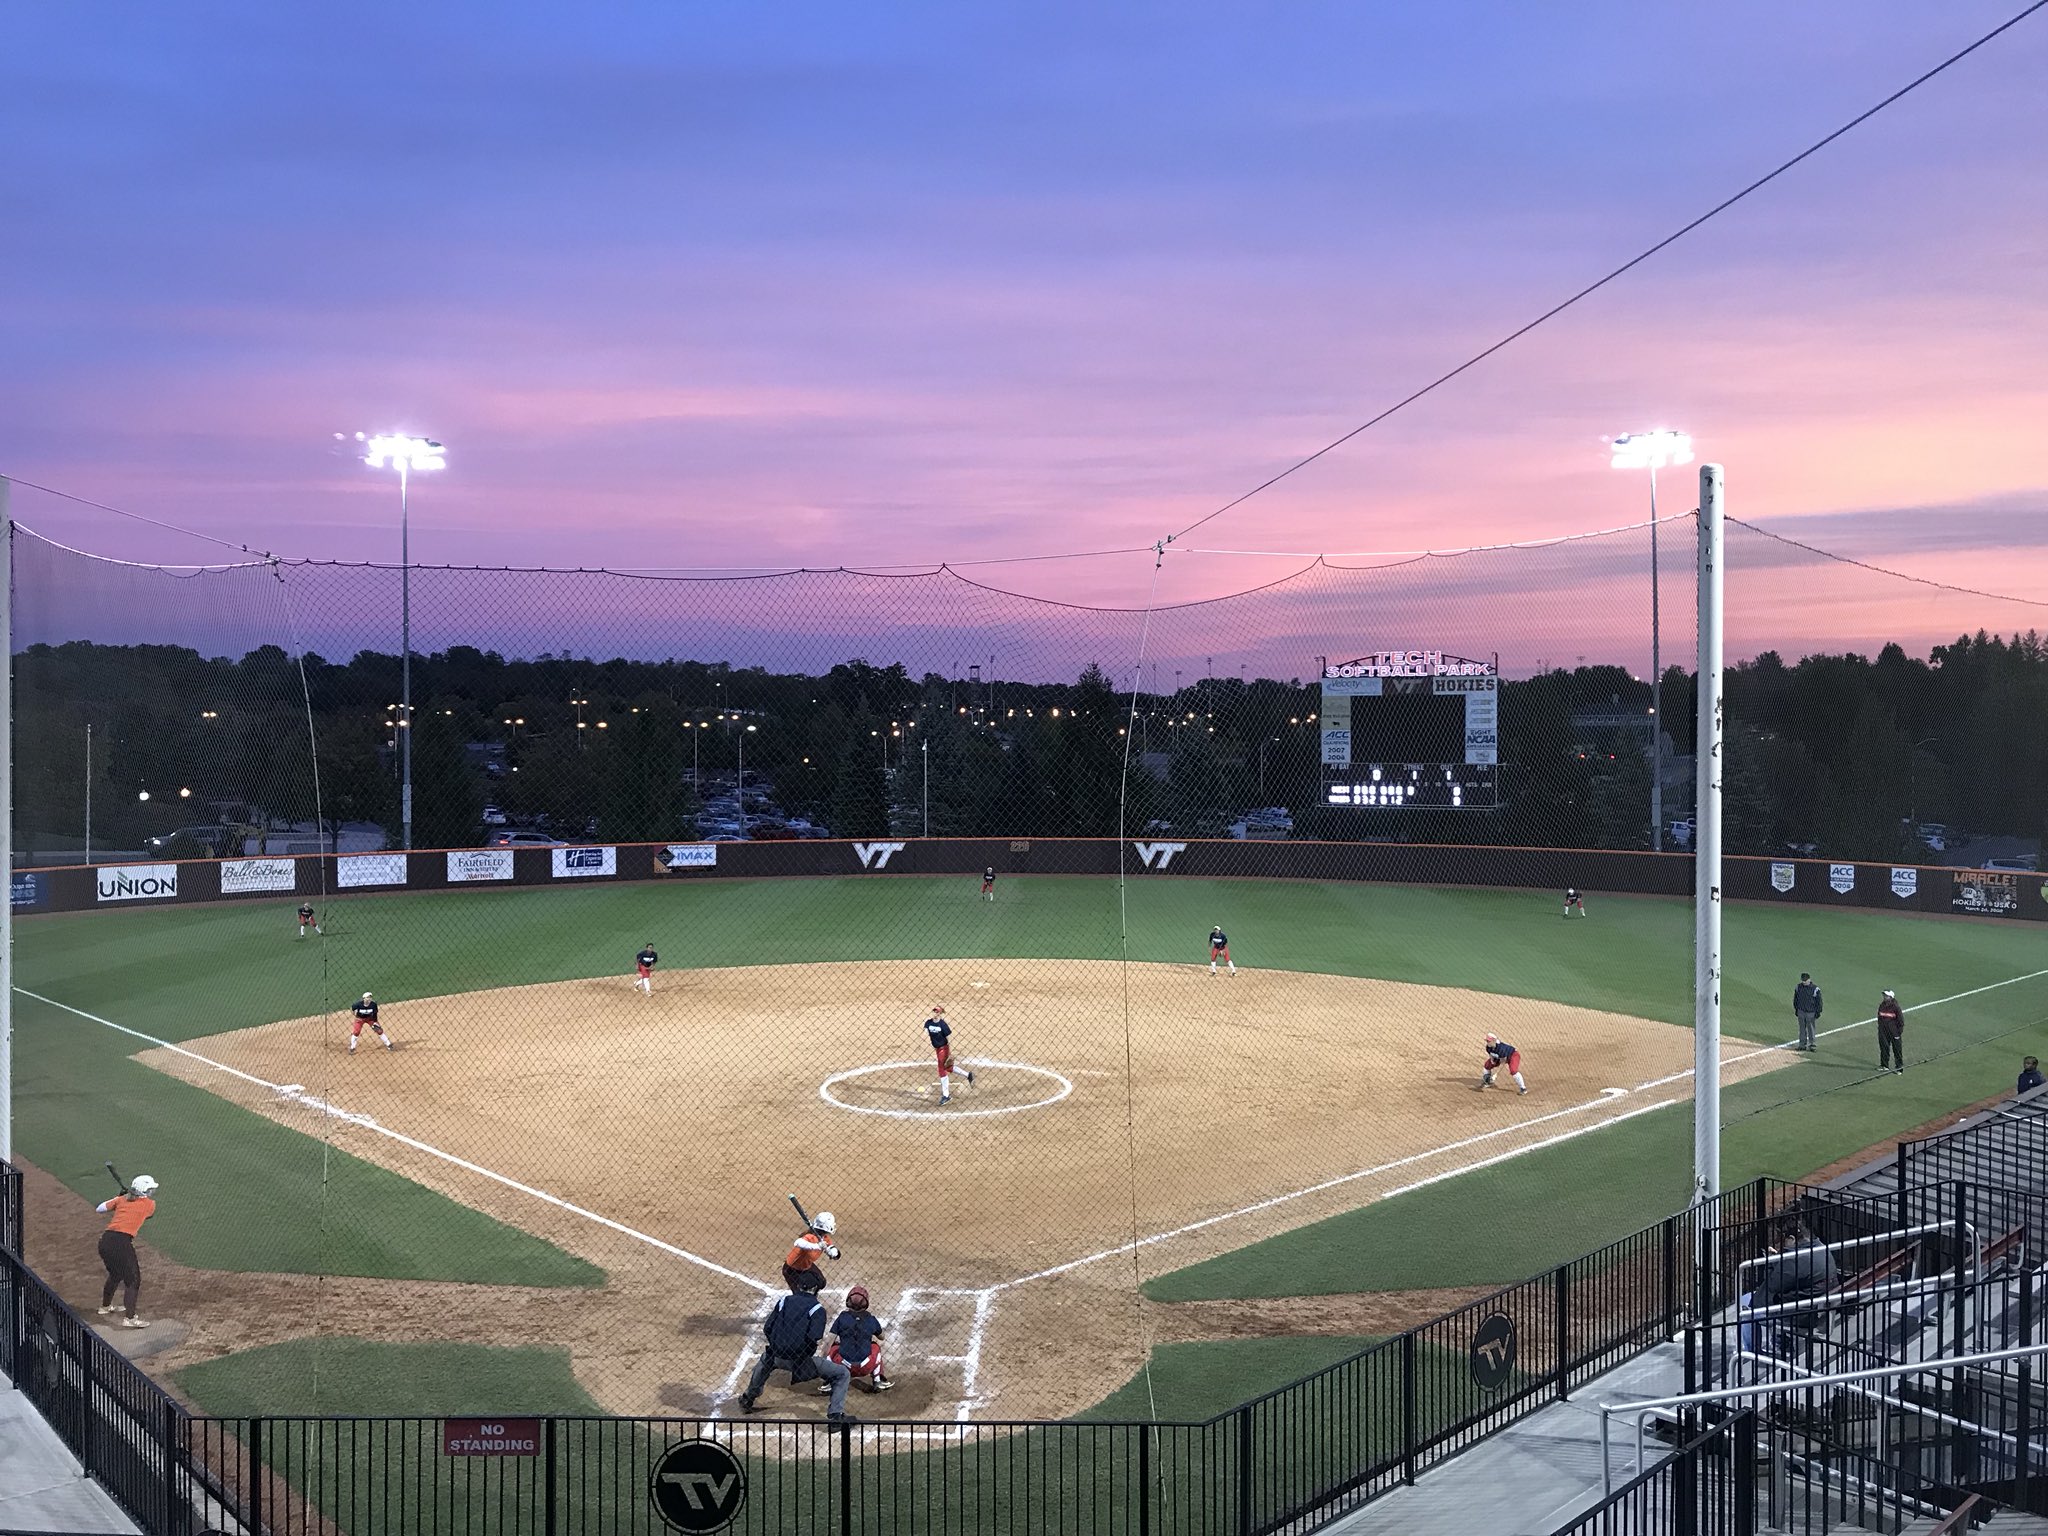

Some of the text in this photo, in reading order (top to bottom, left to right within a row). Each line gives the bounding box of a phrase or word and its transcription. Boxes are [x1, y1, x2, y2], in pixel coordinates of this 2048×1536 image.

[1375, 650, 1442, 665] TECH
[1326, 663, 1490, 678] SOFTBALL PARK
[1392, 679, 1424, 694] VT
[1435, 679, 1495, 692] HOKIES
[1325, 731, 1350, 739] ACC
[1466, 735, 1496, 744] NCAA
[677, 852, 713, 860] IMAX
[852, 842, 906, 869] VT
[1134, 842, 1188, 869] VT
[458, 858, 504, 867] FAIRFIELD
[1831, 867, 1853, 876] ACC
[1893, 871, 1916, 880] ACC
[1953, 872, 2011, 886] MIRACLE
[99, 877, 175, 898] UNION
[1952, 899, 1981, 907] HOKIES
[480, 1424, 505, 1435] NO
[450, 1439, 535, 1451] STANDING
